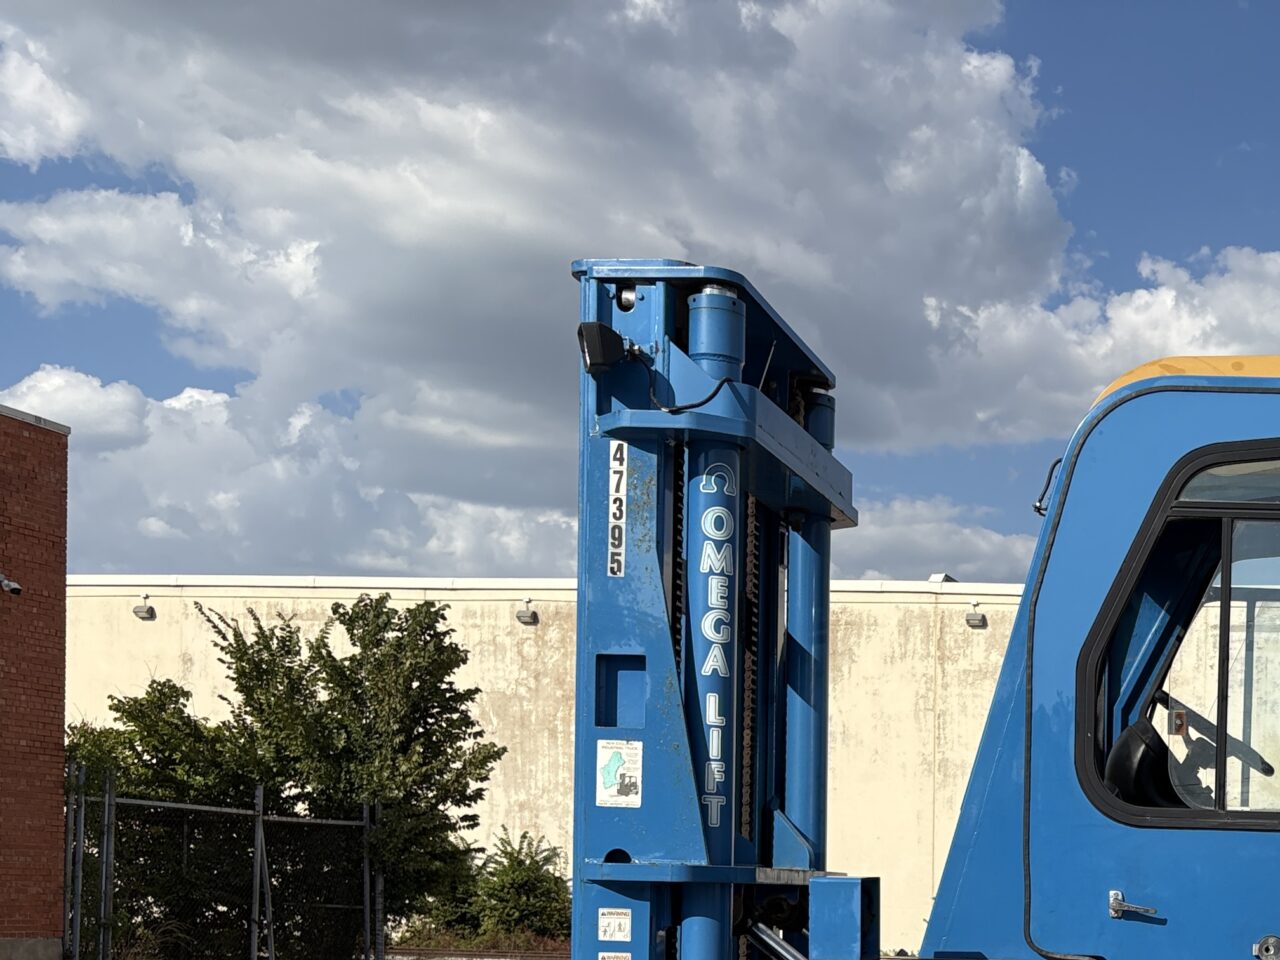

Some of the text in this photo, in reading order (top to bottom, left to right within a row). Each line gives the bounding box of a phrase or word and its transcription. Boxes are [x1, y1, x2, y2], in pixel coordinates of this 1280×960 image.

[609, 442, 626, 576] 47395
[699, 506, 735, 828] OMEGA LIFT
